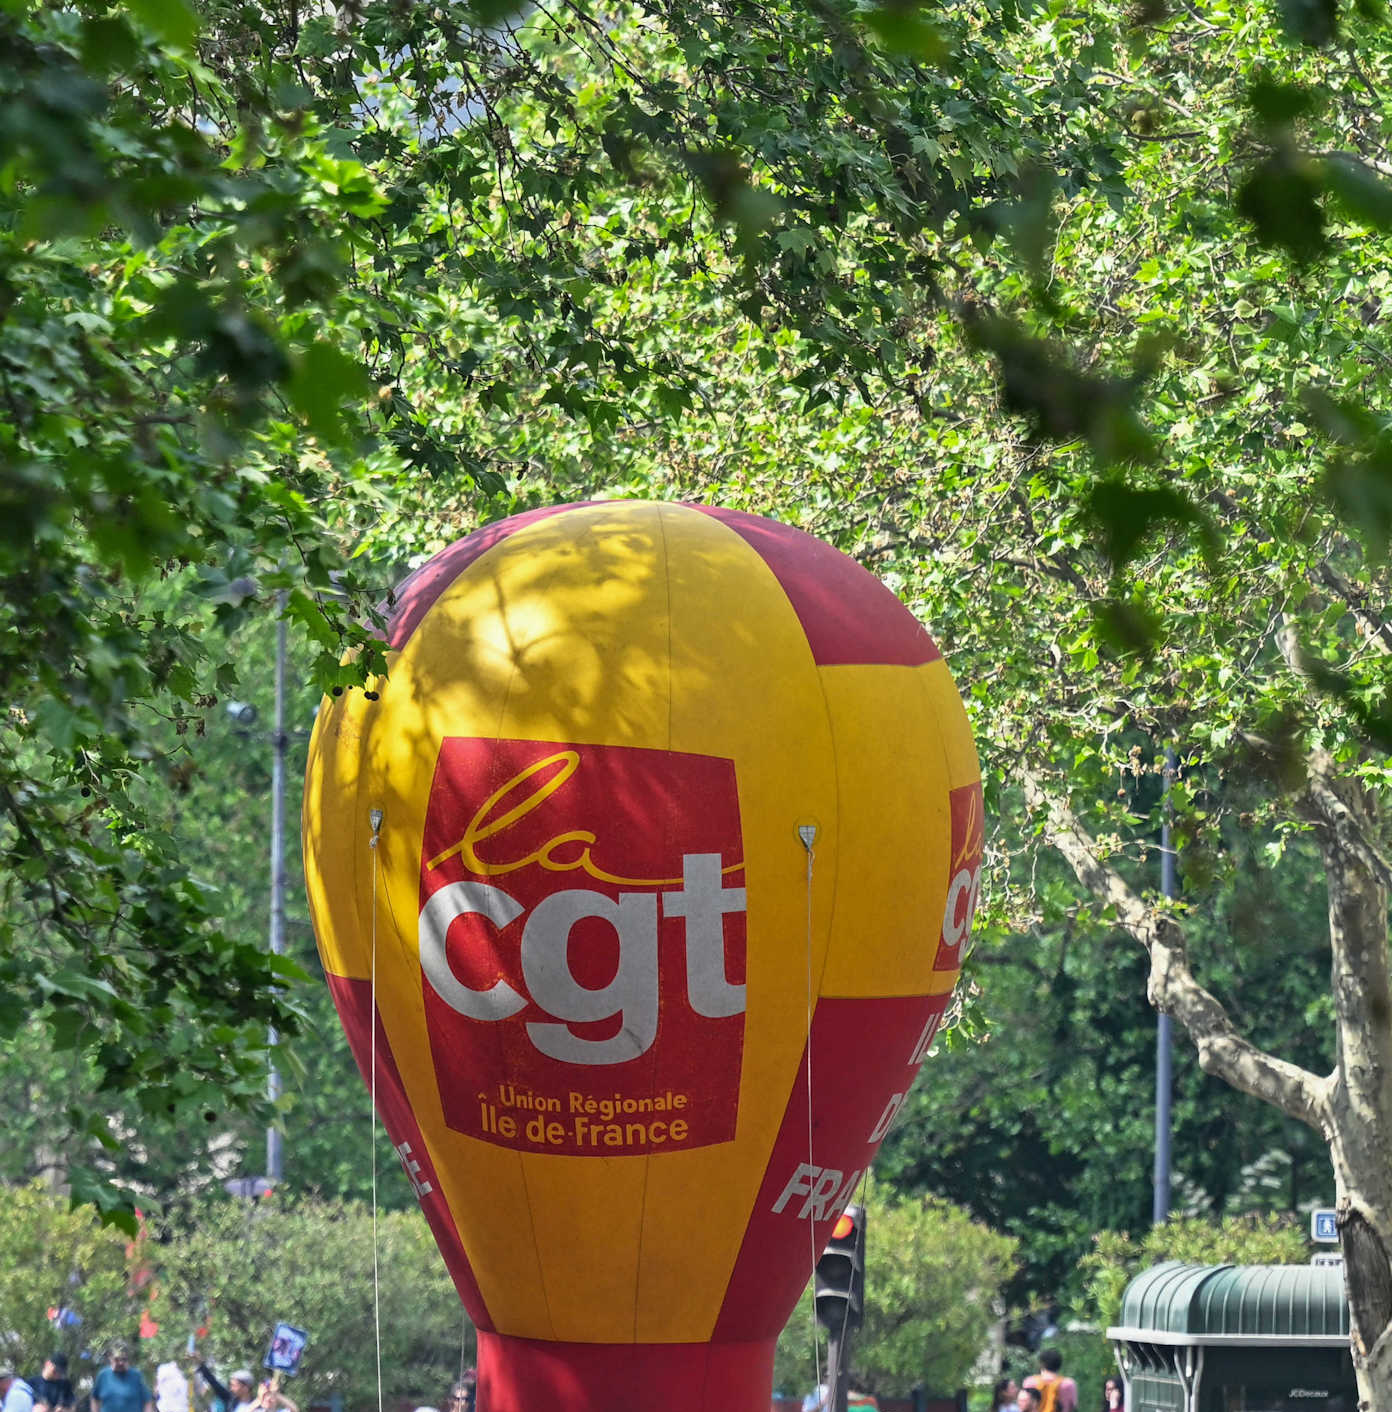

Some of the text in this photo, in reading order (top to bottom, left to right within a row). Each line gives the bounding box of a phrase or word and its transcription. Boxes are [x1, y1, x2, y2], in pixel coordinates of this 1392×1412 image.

[418, 853, 746, 1065] cgt
[499, 1084, 688, 1121] Union Régionale
